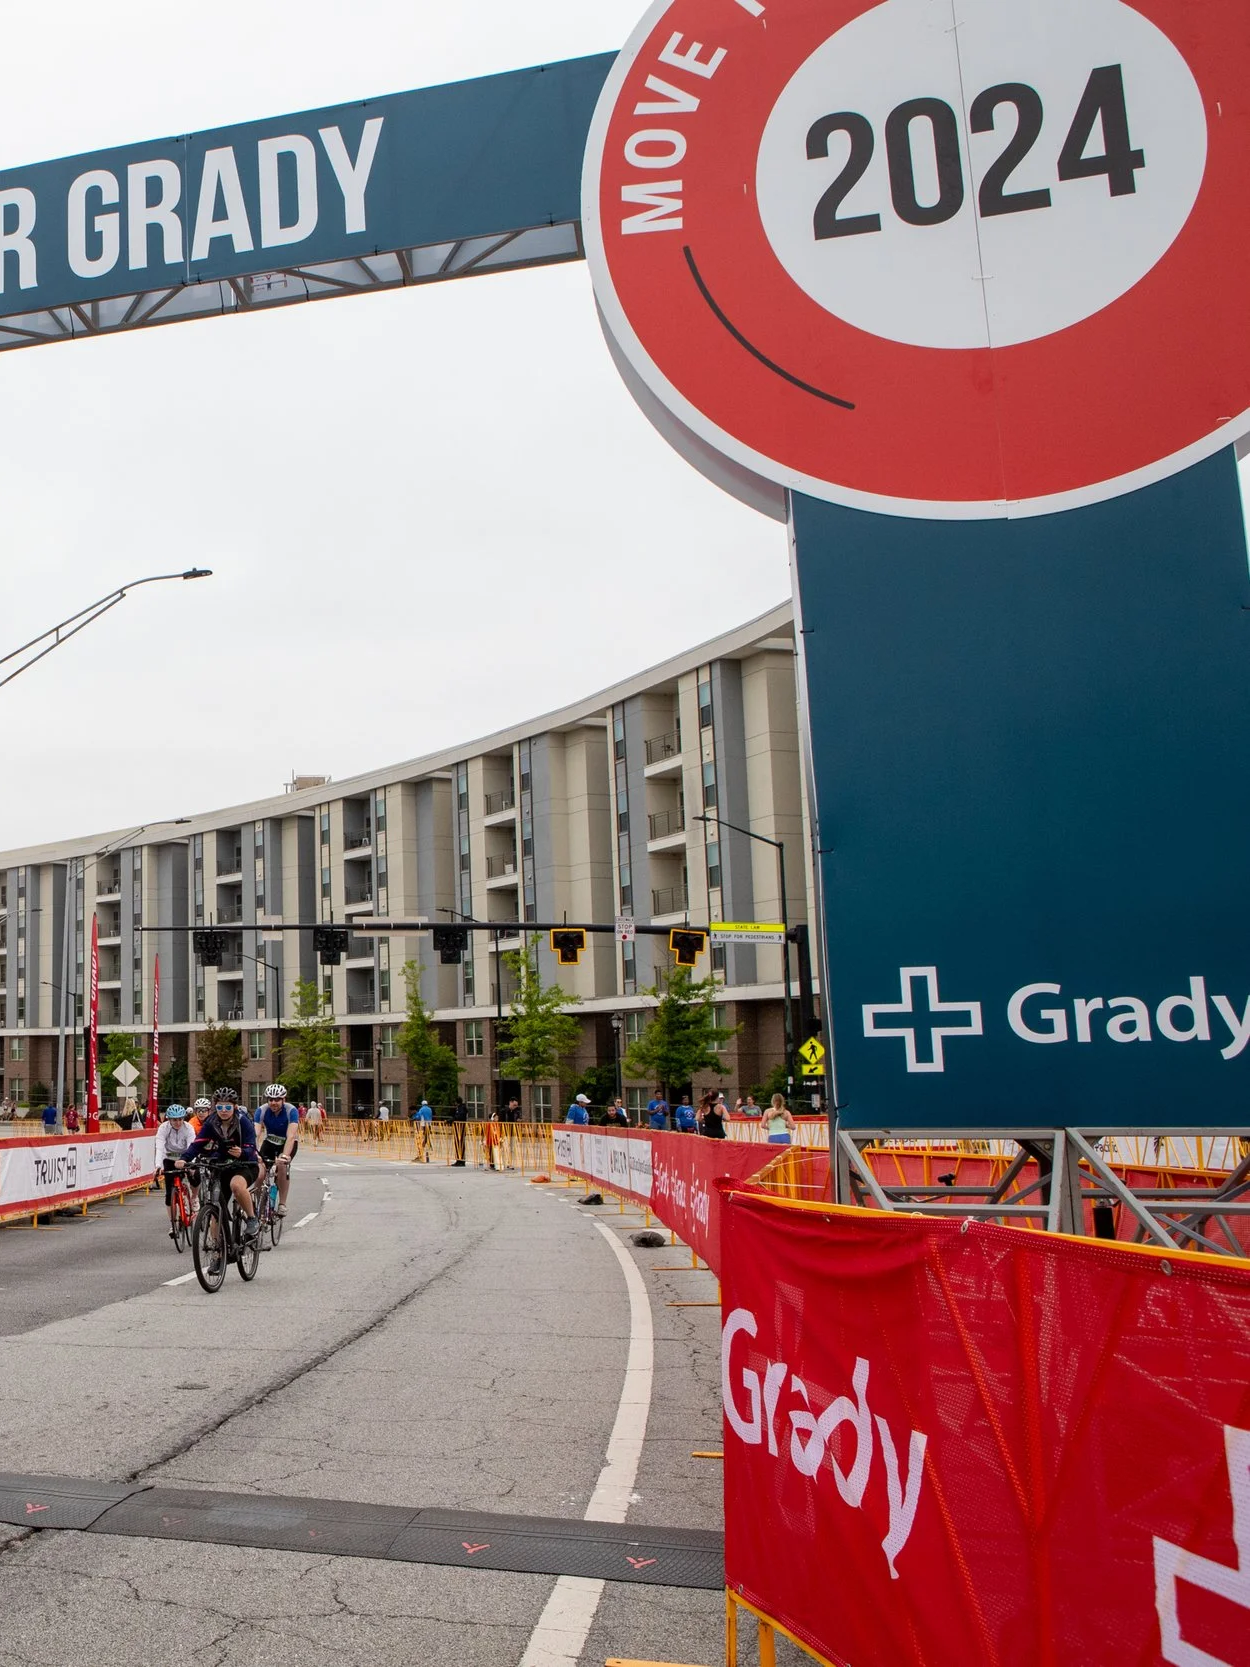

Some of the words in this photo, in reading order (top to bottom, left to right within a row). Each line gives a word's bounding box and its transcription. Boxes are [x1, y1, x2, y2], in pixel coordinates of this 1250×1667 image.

[67, 117, 385, 279] GRADY
[621, 30, 728, 235] MOVE
[805, 63, 1145, 241] 2024
[1007, 975, 1250, 1060] Grady
[34, 1156, 67, 1186] TRUIST
[722, 1307, 928, 1580] Grady
